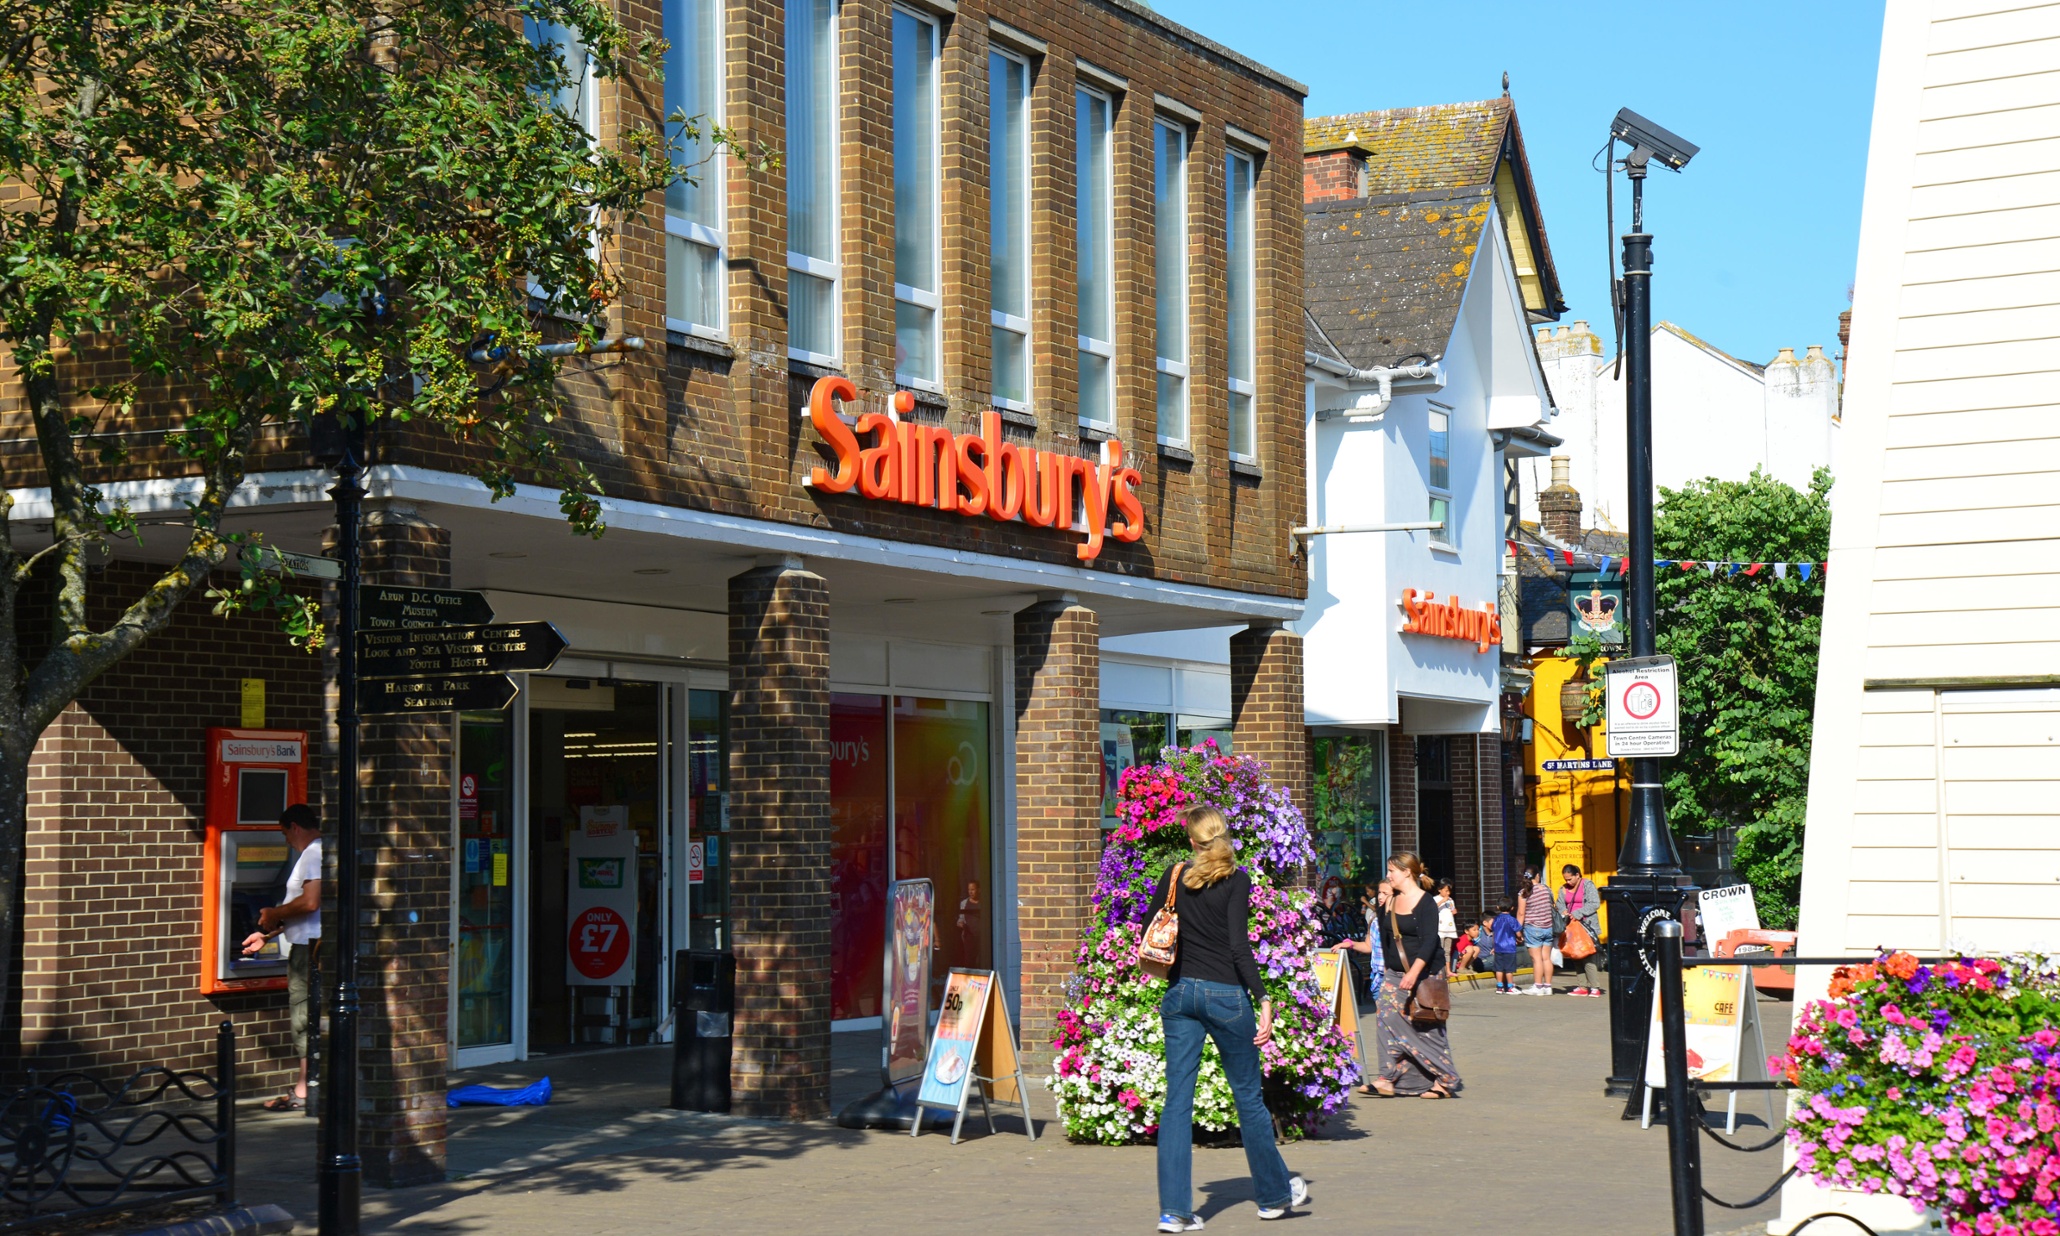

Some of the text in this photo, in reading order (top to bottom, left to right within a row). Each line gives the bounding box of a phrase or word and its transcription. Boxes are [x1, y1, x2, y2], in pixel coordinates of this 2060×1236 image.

[808, 375, 1145, 561] Sainsbury's
[379, 590, 462, 606] ARUN D.C. OFFICE
[402, 605, 438, 617] MUSEUM
[370, 616, 395, 628] TOWN
[1402, 588, 1502, 654] Sainsbury's
[365, 628, 520, 645] VISITOR INFORMATION CENTRE
[364, 641, 527, 658] LOOK AND SEA VISITOR CENTRE
[409, 657, 488, 670] YOUTH HOSTEL
[385, 681, 470, 694] HARBOUR PARK
[404, 697, 454, 707] SEAFRONT
[227, 744, 296, 759] Sainsbury's Bank
[1556, 761, 1590, 769] MARTINS
[1592, 760, 1612, 768] LANE
[1702, 885, 1746, 901] CROWN
[586, 912, 613, 922] ONLY
[1639, 908, 1671, 934] WELCOME
[579, 923, 619, 952] £7
[944, 992, 963, 1015] 50p
